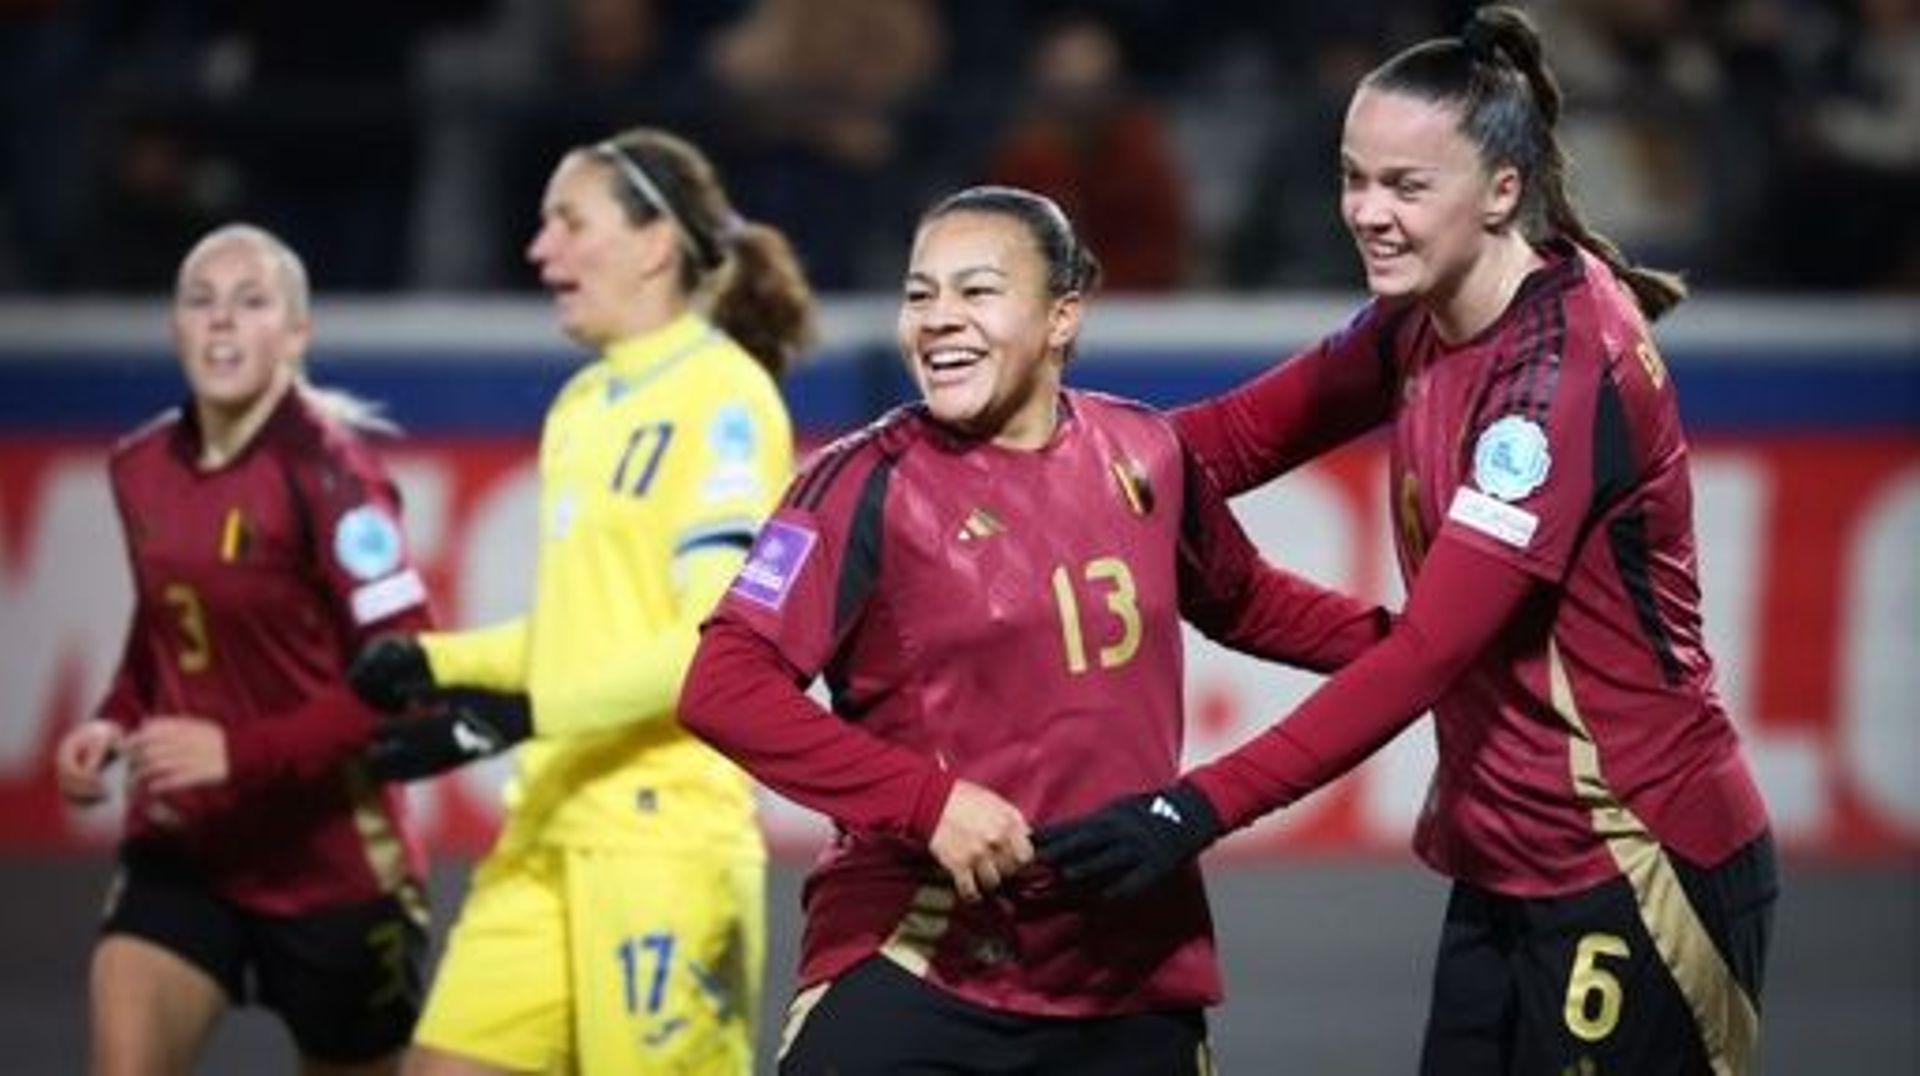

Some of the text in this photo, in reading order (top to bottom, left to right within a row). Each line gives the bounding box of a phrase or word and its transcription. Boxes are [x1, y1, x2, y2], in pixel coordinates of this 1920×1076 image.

[611, 421, 675, 498] 17
[164, 584, 208, 673] 3
[1052, 557, 1142, 673] 13
[618, 932, 675, 1016] 17
[1564, 931, 1632, 1041] 6
